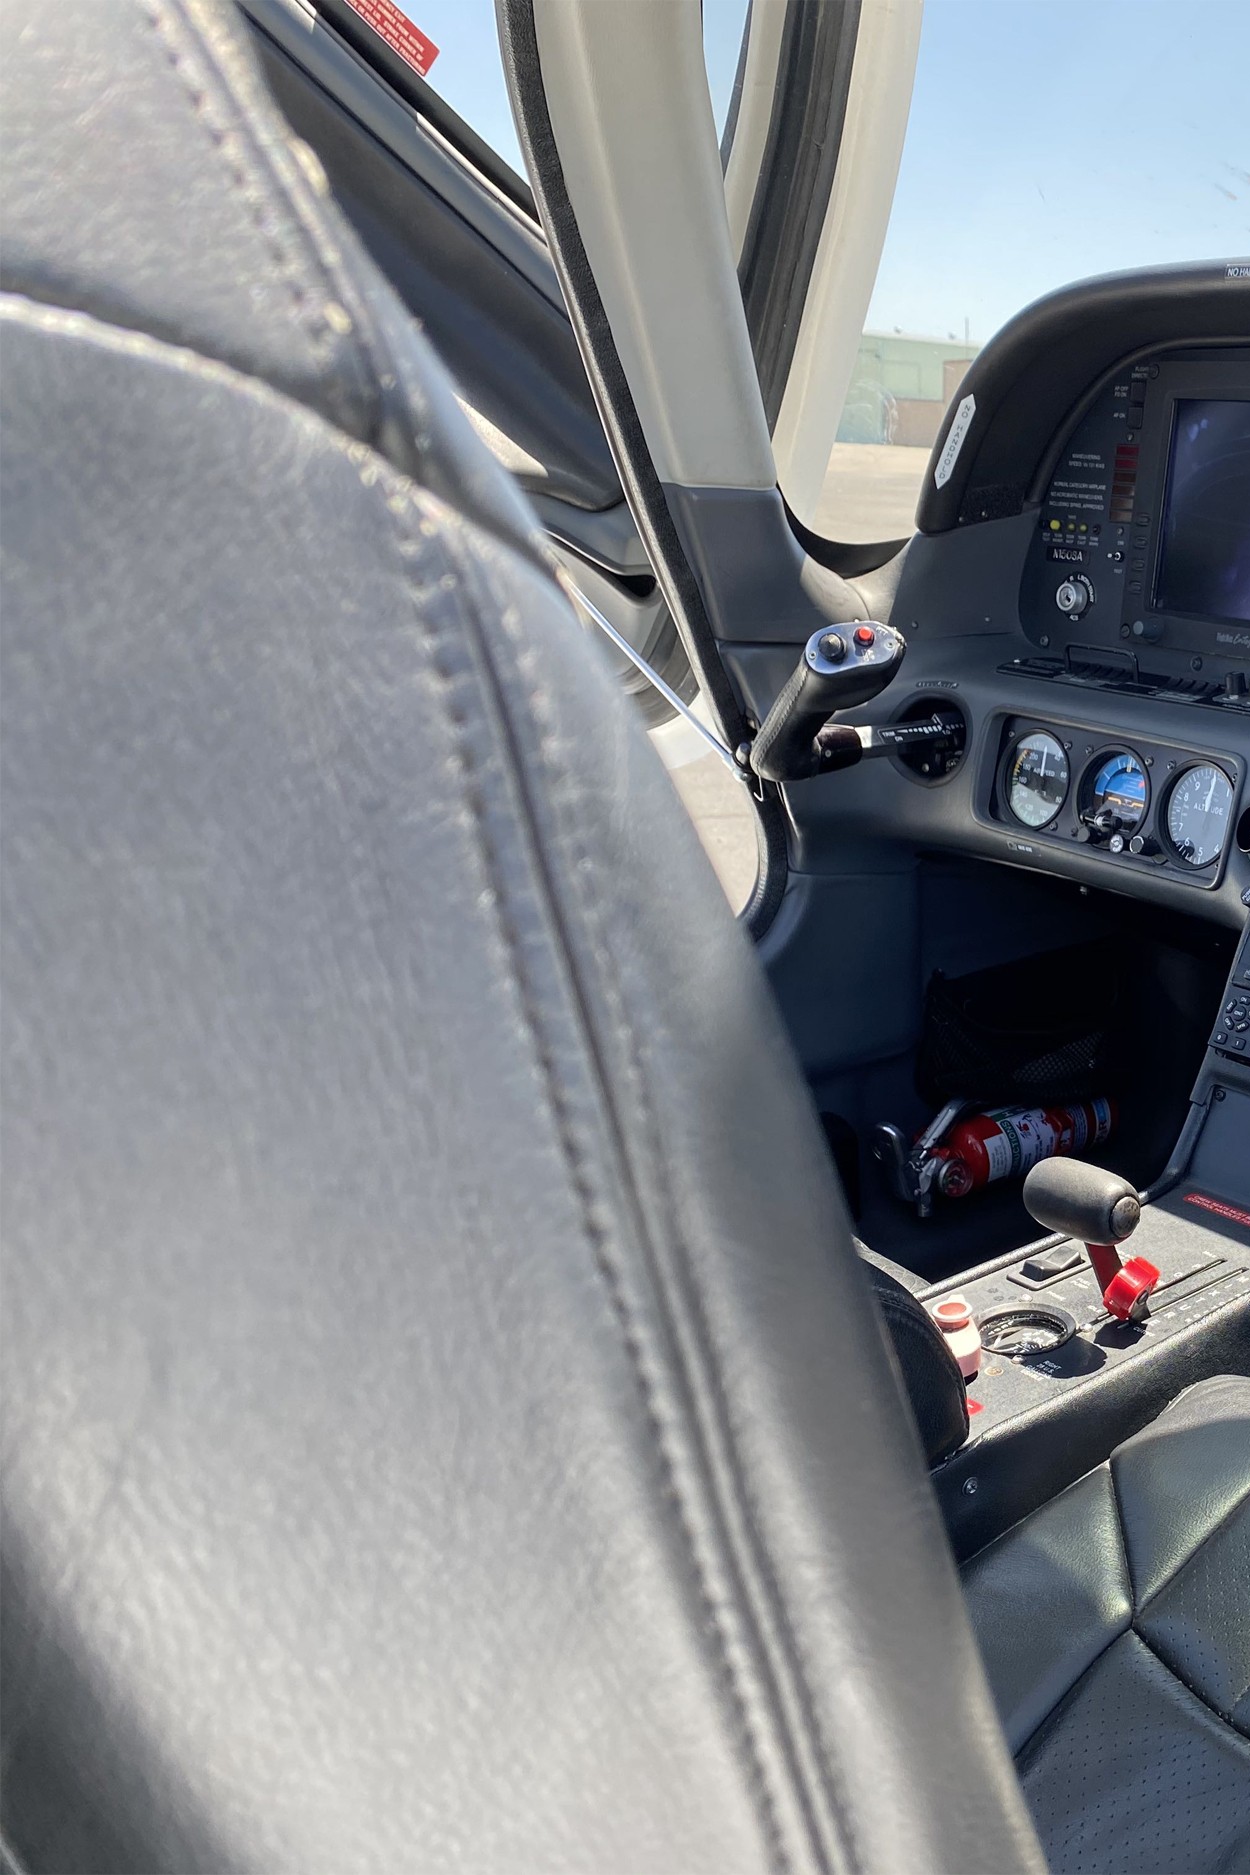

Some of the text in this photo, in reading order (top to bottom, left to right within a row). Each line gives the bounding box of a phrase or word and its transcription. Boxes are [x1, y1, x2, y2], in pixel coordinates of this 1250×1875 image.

[1227, 267, 1239, 276] NO
[961, 404, 971, 418] NO
[1195, 781, 1200, 790] 9
[1056, 796, 1062, 804] 80
[1184, 792, 1188, 802] 8
[1194, 802, 1224, 816] ALTUDE
[1178, 823, 1184, 831] 7
[1184, 836, 1190, 846] 6
[1198, 847, 1203, 856] 5
